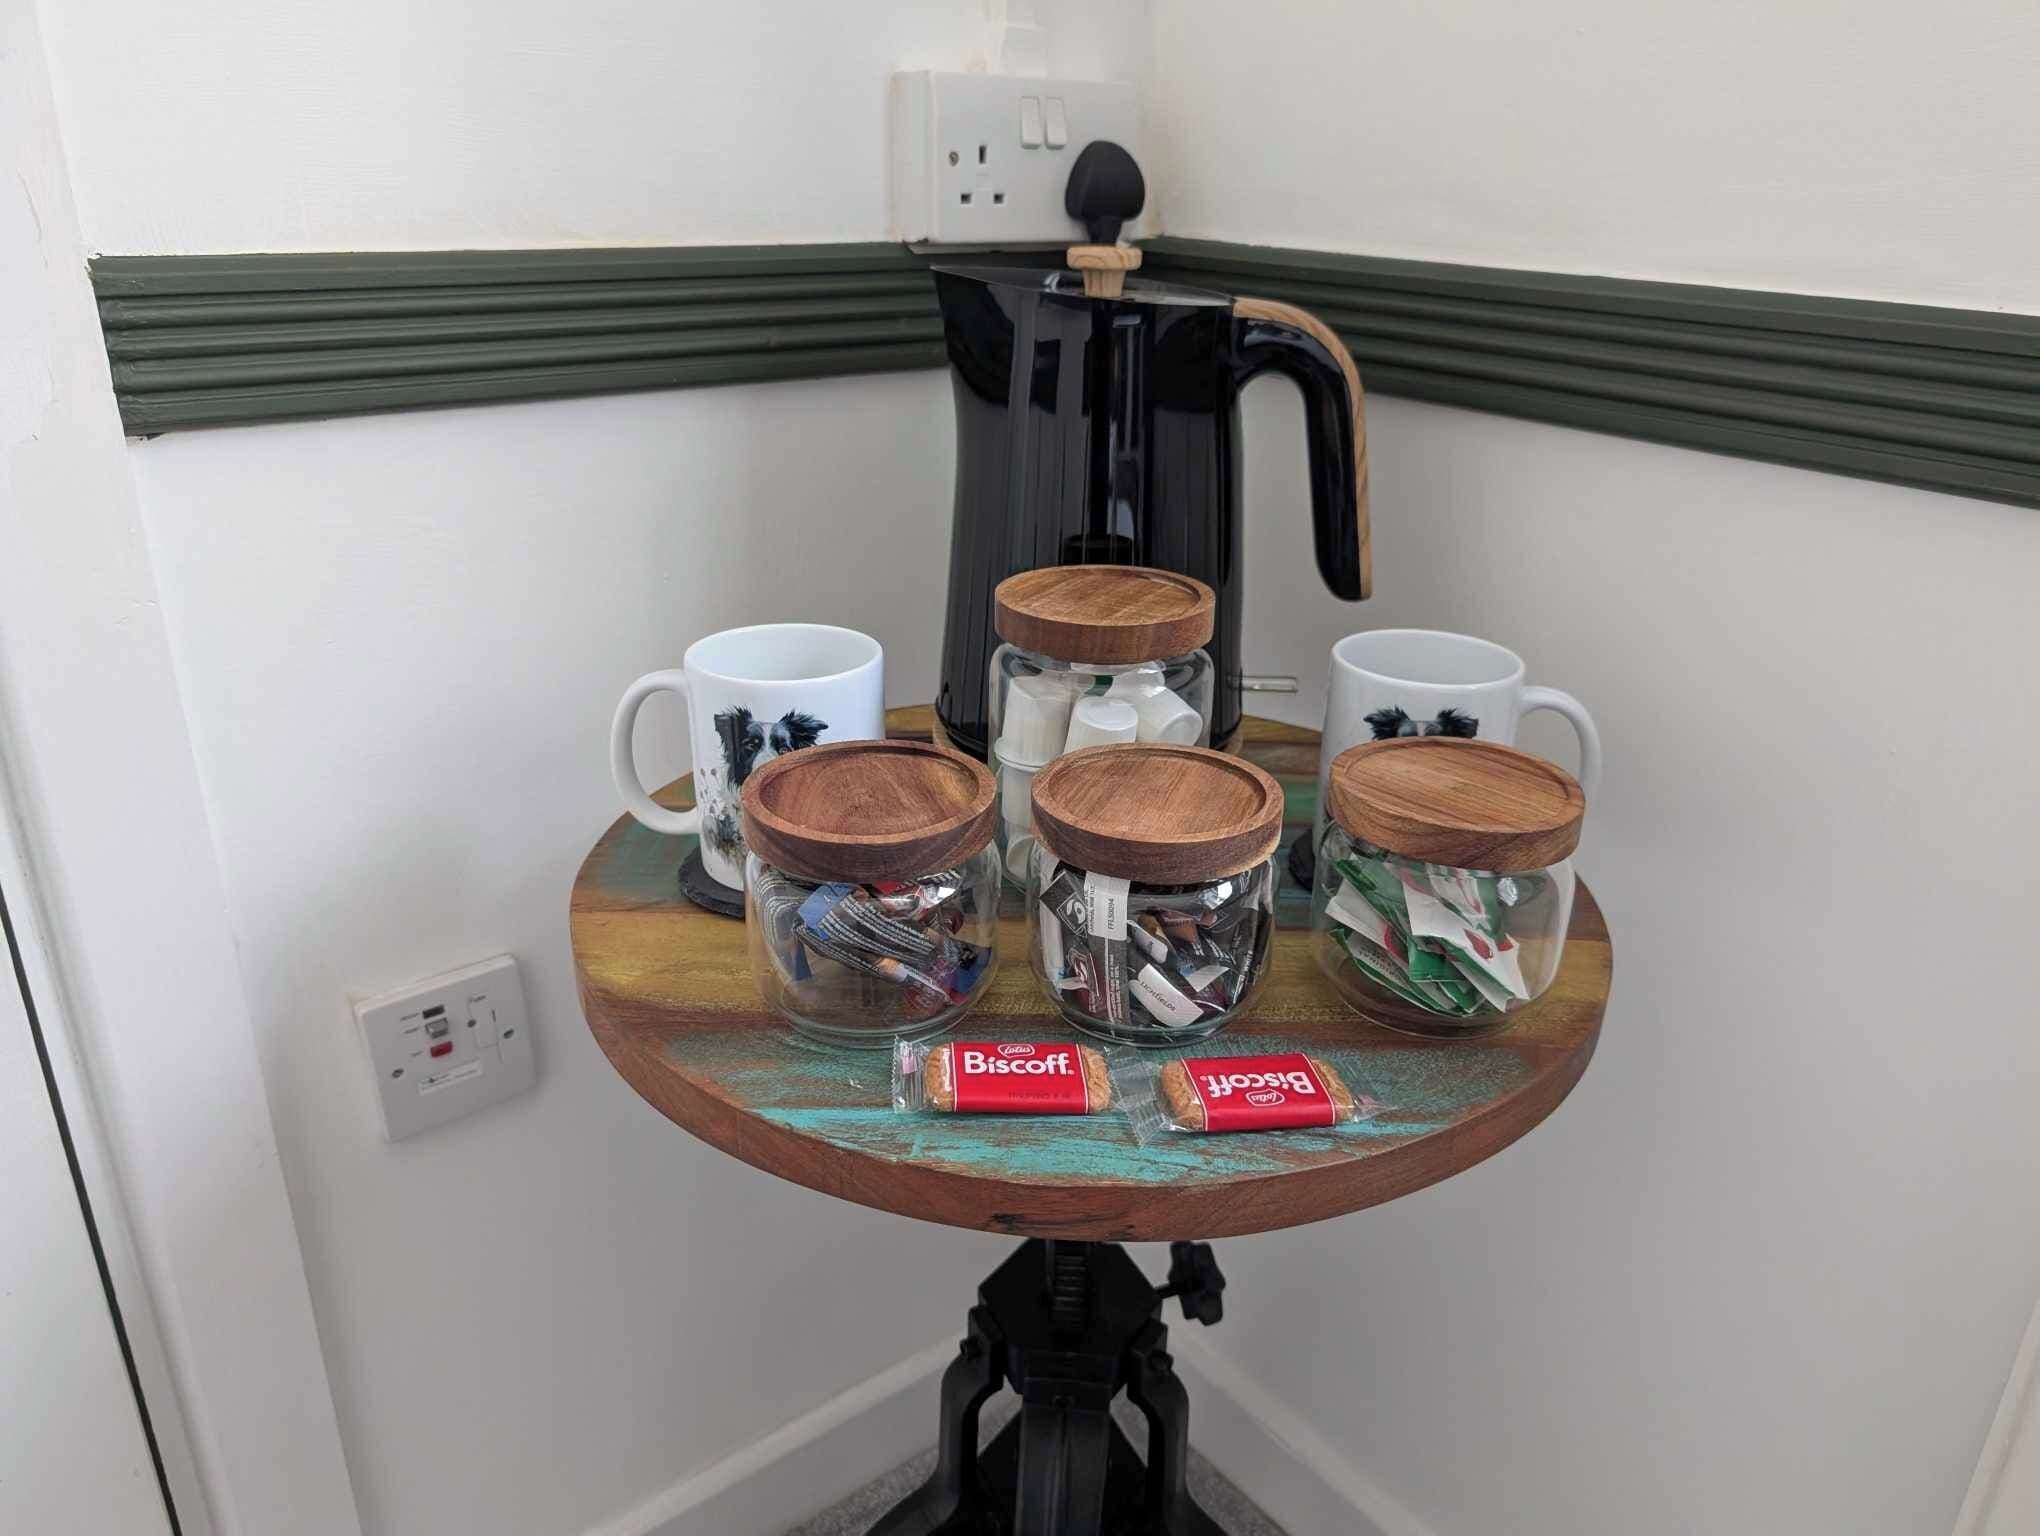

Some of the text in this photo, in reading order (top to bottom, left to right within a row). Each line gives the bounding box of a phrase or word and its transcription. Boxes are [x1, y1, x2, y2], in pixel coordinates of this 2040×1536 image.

[1004, 1045, 1031, 1054] Lotus
[963, 1051, 1071, 1075] Biscoff
[1206, 1071, 1316, 1098] Biscoff
[1250, 1091, 1278, 1103] Lotus
